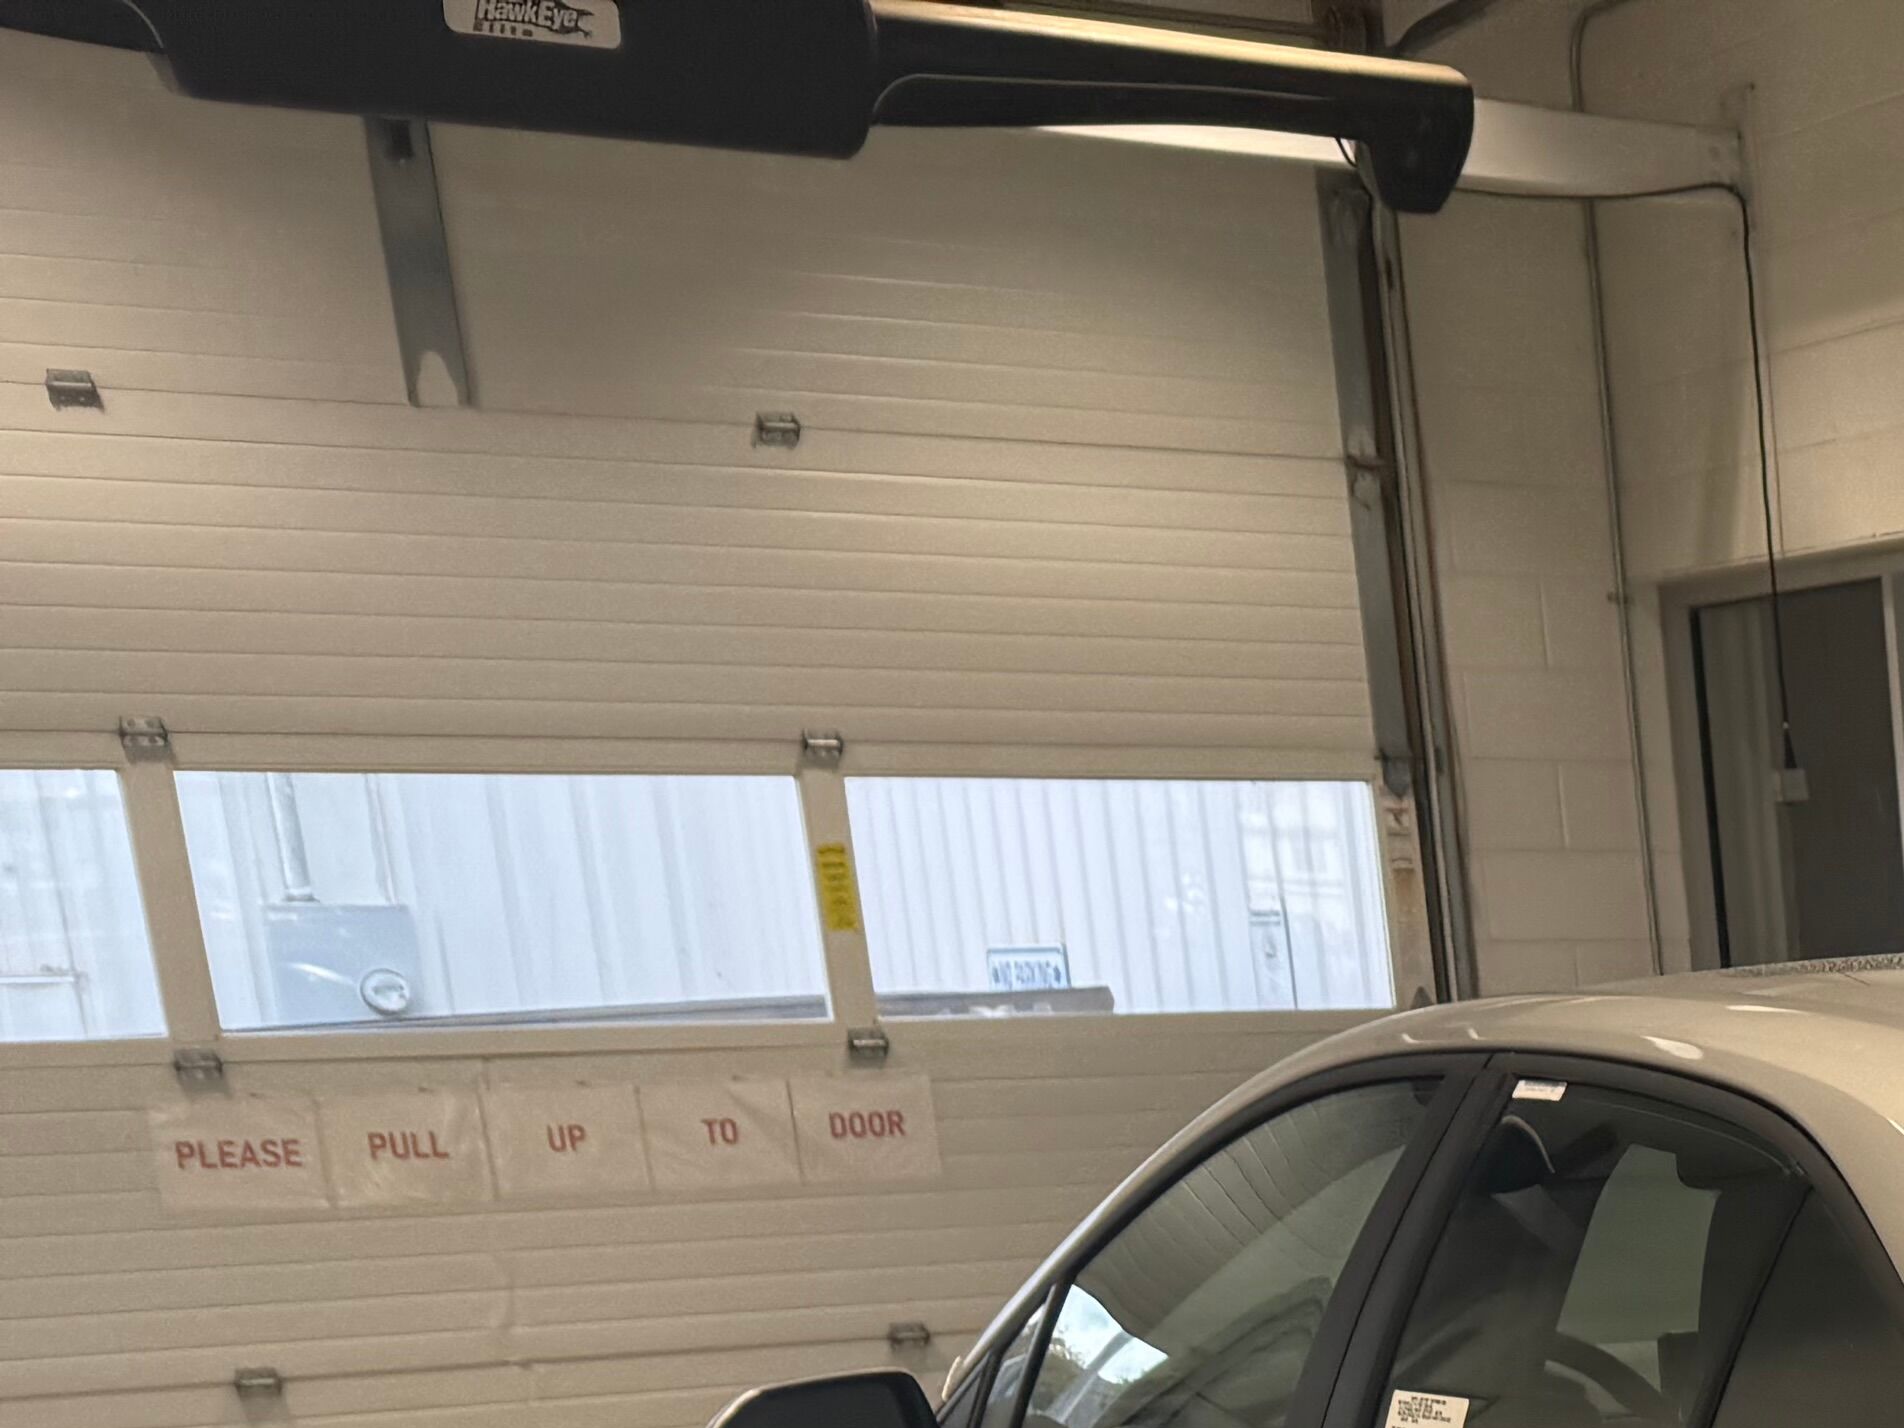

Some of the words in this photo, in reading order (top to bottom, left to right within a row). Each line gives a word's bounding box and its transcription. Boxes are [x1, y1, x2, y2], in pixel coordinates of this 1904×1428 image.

[475, 0, 578, 30] HawkEye
[174, 1137, 305, 1172] PLEASE
[367, 1129, 450, 1162] PULL
[547, 1124, 588, 1154] UP
[701, 1117, 740, 1147] TO
[827, 1109, 907, 1140] DOOR
